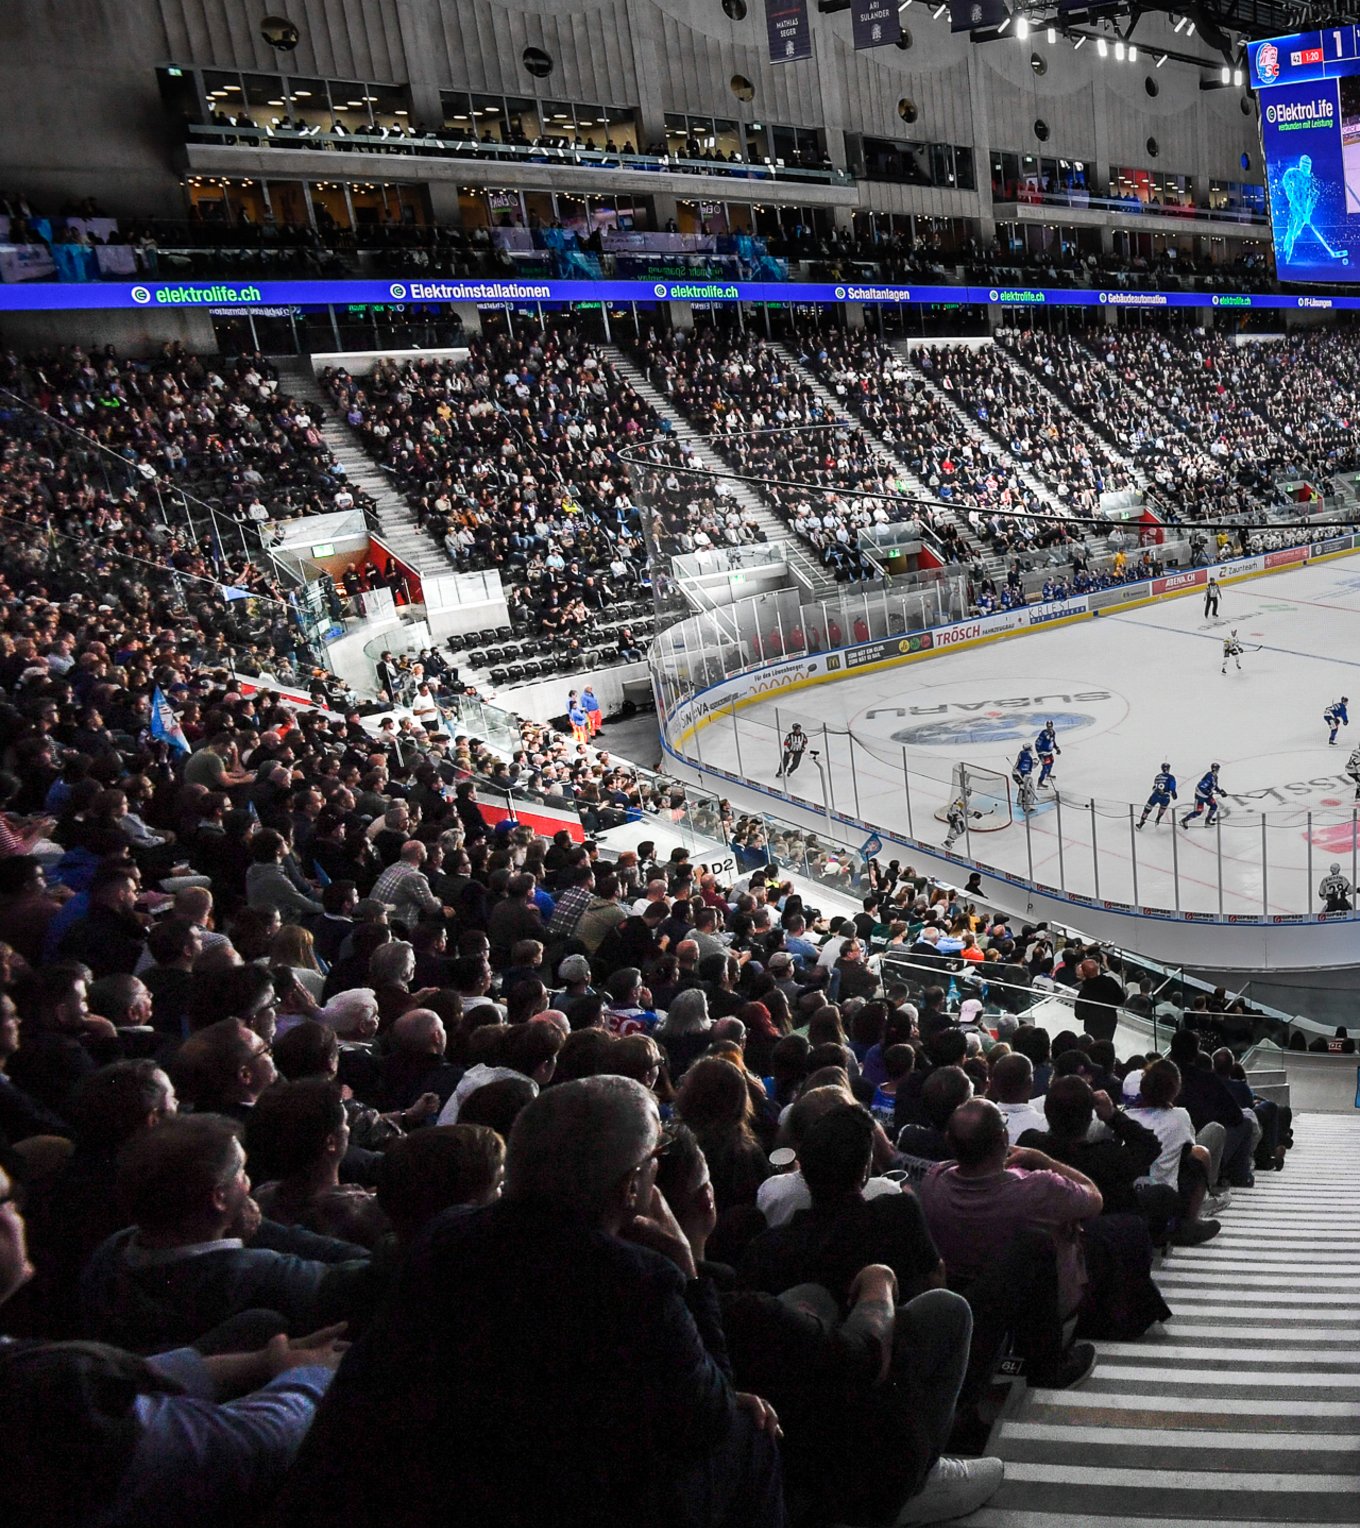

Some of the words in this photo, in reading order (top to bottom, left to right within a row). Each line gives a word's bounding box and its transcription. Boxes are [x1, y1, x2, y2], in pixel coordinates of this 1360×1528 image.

[776, 17, 799, 29] MATHIAS
[860, 9, 890, 22] SULANDER
[780, 28, 796, 38] SEGER
[1333, 30, 1343, 58] 1
[1305, 51, 1319, 62] 1:20
[1277, 99, 1334, 122] ElektroLife
[155, 285, 262, 304] elektrolife.ch
[410, 283, 551, 300] Elektroinstallationen
[670, 284, 739, 299] elektrolife.ch
[847, 287, 911, 302] Schaltanlagen
[1000, 291, 1046, 302] elektrolife.ch
[1107, 292, 1168, 305] Gebäudeautomation
[935, 624, 981, 646] TRÖSCH
[866, 691, 1112, 720] SUBARU
[712, 858, 734, 875] D2
